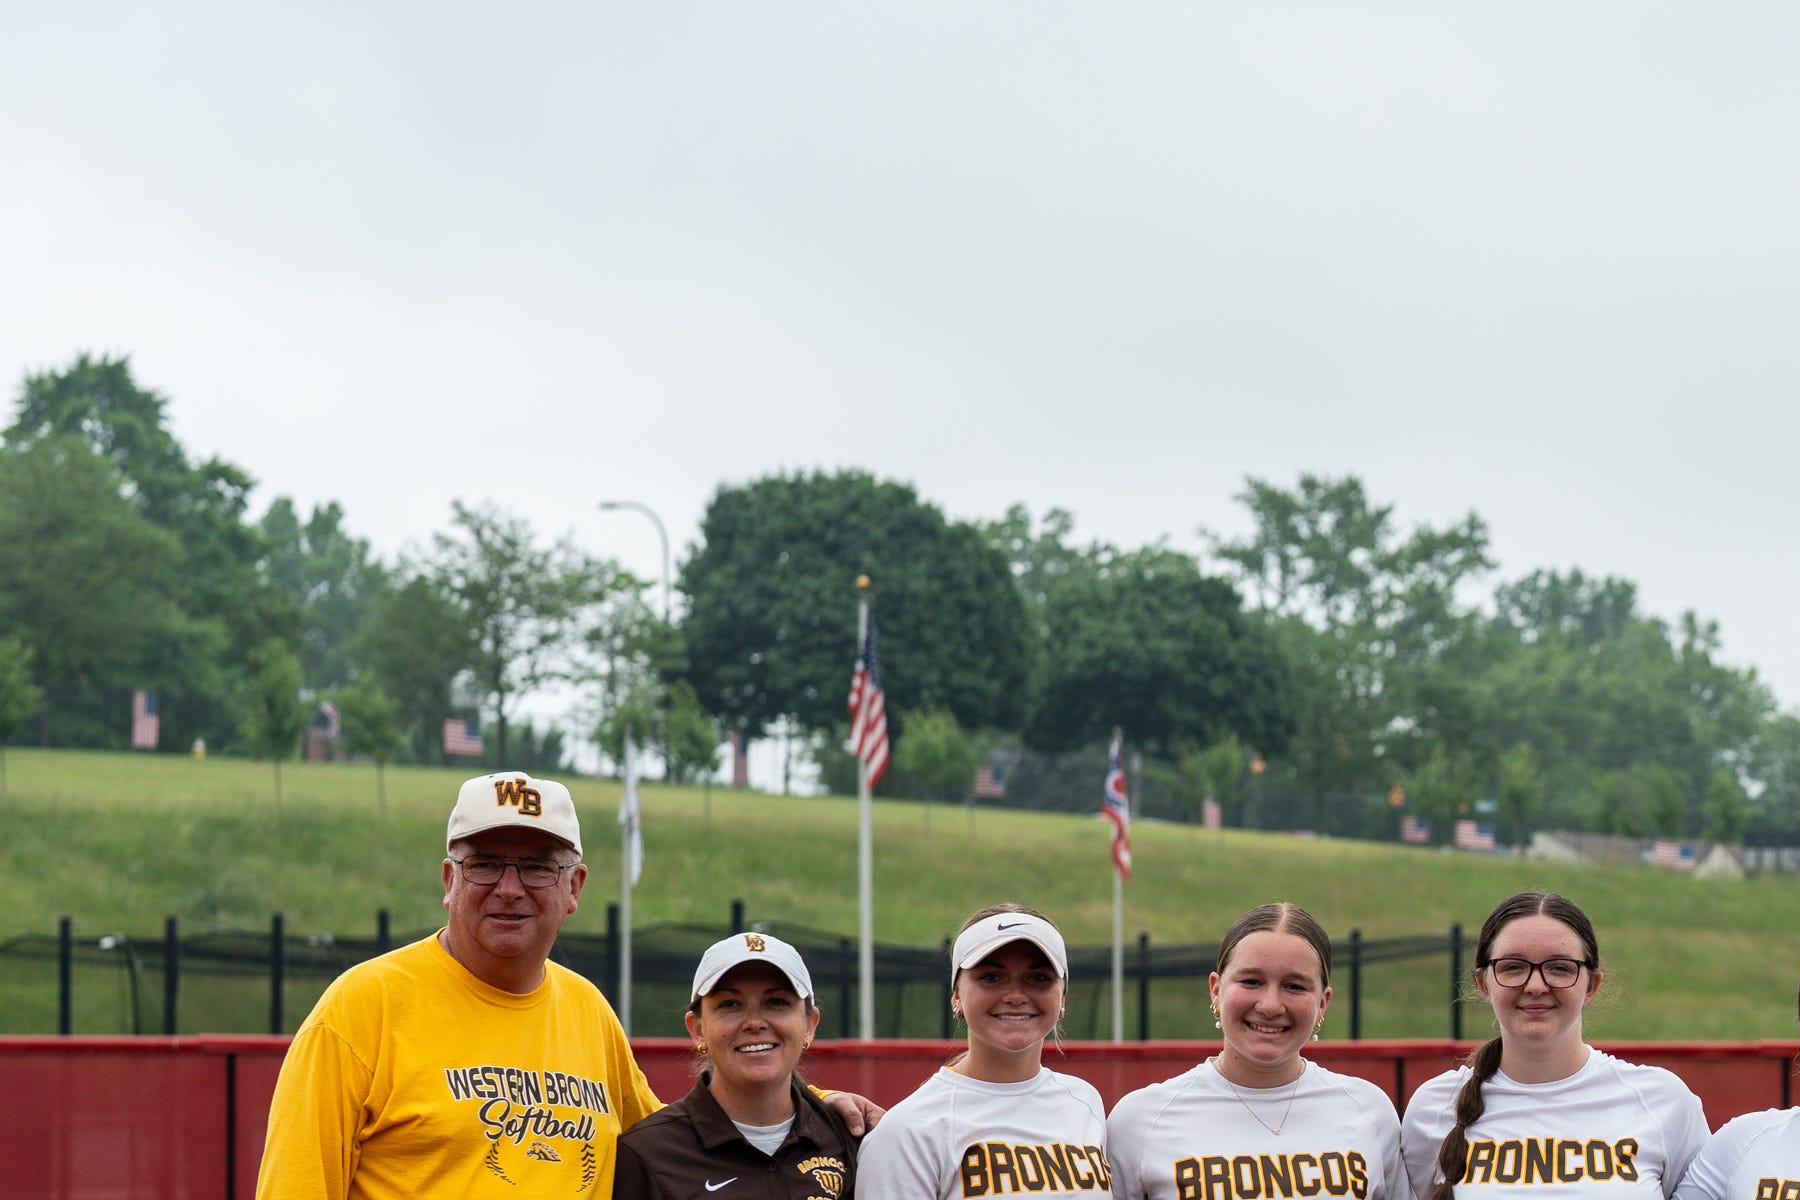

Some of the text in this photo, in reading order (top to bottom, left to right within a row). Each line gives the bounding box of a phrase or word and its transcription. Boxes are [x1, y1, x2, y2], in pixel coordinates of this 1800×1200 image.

[495, 779, 542, 817] WB
[445, 1065, 543, 1106] WESTERN
[478, 1097, 596, 1145] Softball
[1463, 1137, 1639, 1185] RONCOS
